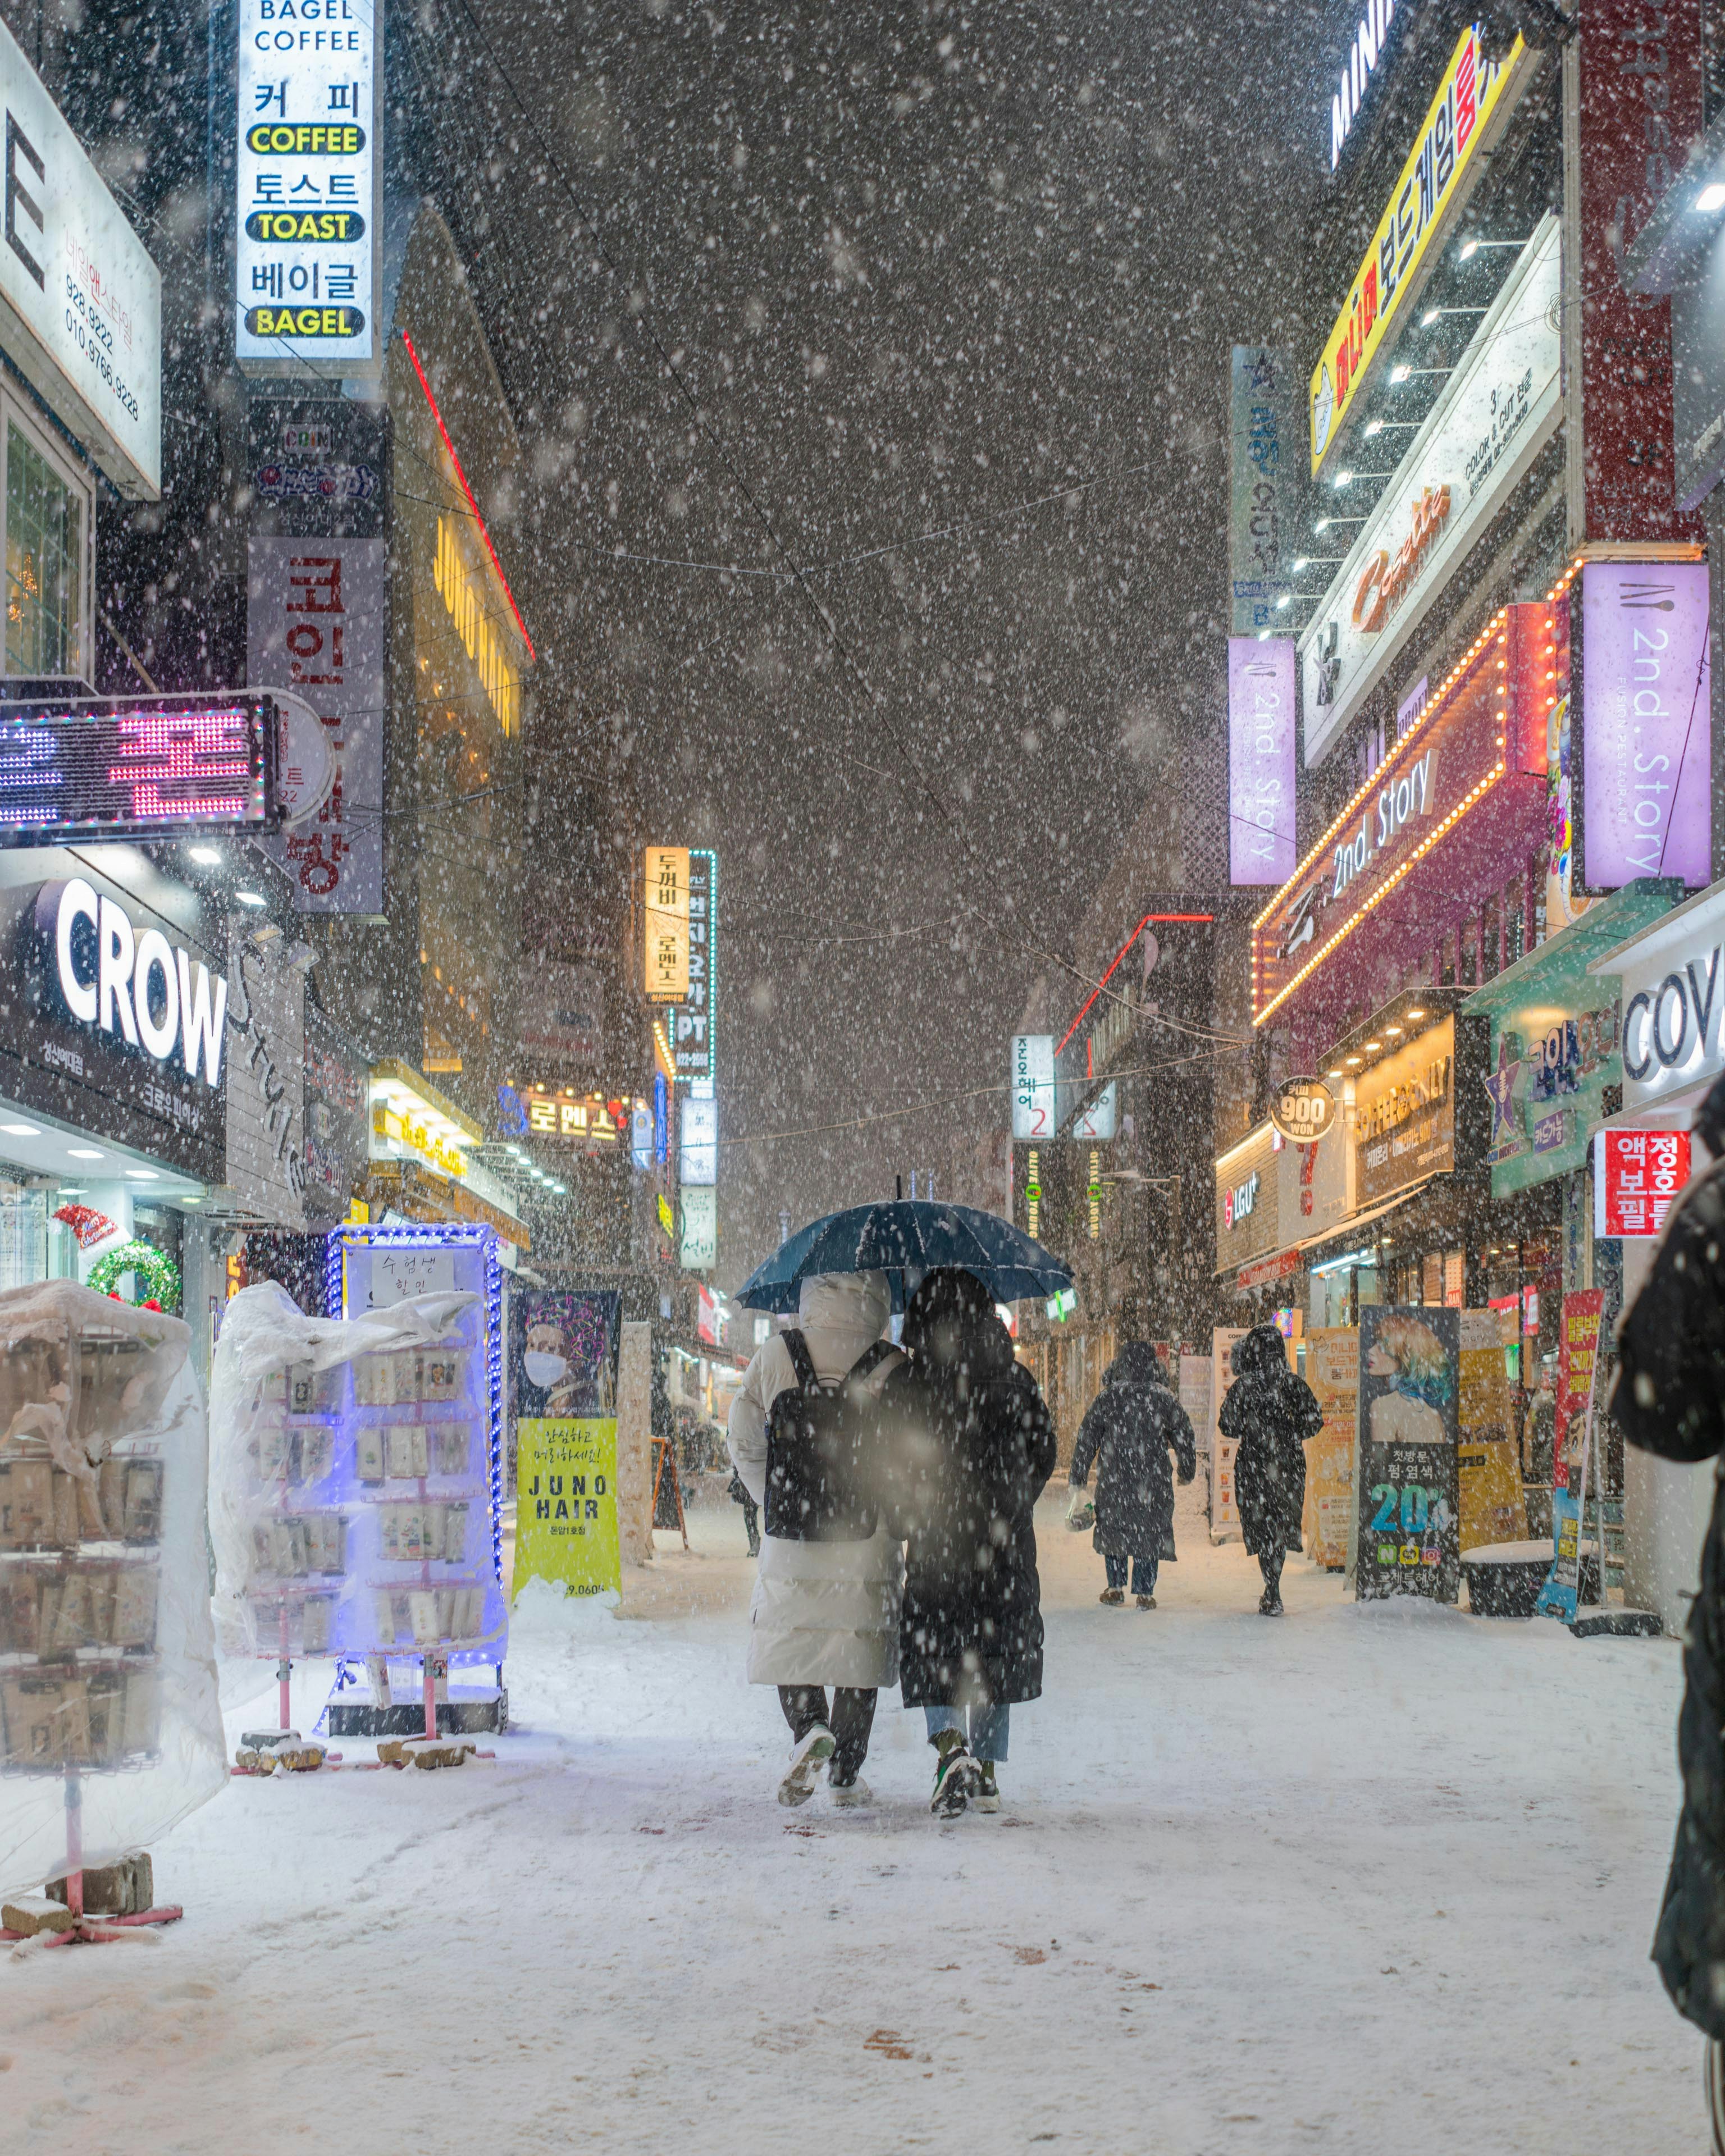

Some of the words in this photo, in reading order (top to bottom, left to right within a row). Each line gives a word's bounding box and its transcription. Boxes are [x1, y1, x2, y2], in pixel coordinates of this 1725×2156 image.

[261, 0, 353, 19] BAGEL
[255, 30, 359, 51] COFFEE
[254, 81, 359, 118] 커피
[252, 127, 358, 153] COFFEE
[253, 175, 359, 205] 토스트
[258, 215, 349, 239] TOAST
[65, 227, 133, 352] 네일앤스타일
[252, 263, 358, 299] 베이글
[66, 274, 113, 355] 928.9222
[257, 309, 352, 335] BAGEL
[1336, 261, 1377, 408] 미니미
[66, 308, 138, 422] 010.9766.9228
[285, 431, 329, 447] COIN
[1465, 435, 1490, 481] COLOR
[1499, 392, 1515, 430] CUT
[1352, 483, 1452, 634] Cosette
[1633, 627, 1669, 734] 2nd.
[1617, 677, 1626, 728] FUSION
[1255, 693, 1281, 765] 2nd.
[1617, 734, 1627, 824] RESTAURANT
[1379, 755, 1430, 847] Story
[1626, 753, 1670, 875] Story
[1251, 778, 1281, 862] Story
[659, 855, 676, 905] 두꺼비
[659, 936, 676, 986] 로멘스
[58, 878, 227, 1089] CROW
[1288, 1085, 1309, 1096] 커피
[530, 1099, 617, 1141] 로멘스
[1031, 1108, 1047, 1136] 2
[1281, 1095, 1326, 1123] 900
[1290, 1122, 1314, 1136] WON
[1535, 1114, 1563, 1145] 카드가능
[1617, 1137, 1678, 1165] 액정
[1029, 1150, 1039, 1184] OLIVE
[1617, 1170, 1681, 1197] 보호
[1028, 1202, 1039, 1240] YOUNG
[382, 1254, 436, 1275] 수험생
[395, 1278, 427, 1296] 할인
[545, 1426, 594, 1444] 안심하고
[534, 1448, 601, 1464] 머리하세요!
[1393, 1449, 1428, 1463] 첫방문
[528, 1474, 606, 1496] JUNO
[536, 1499, 599, 1519] HAIR
[550, 1525, 586, 1536] 돈암1호점
[1377, 1572, 1439, 1584] 코제트헤어
